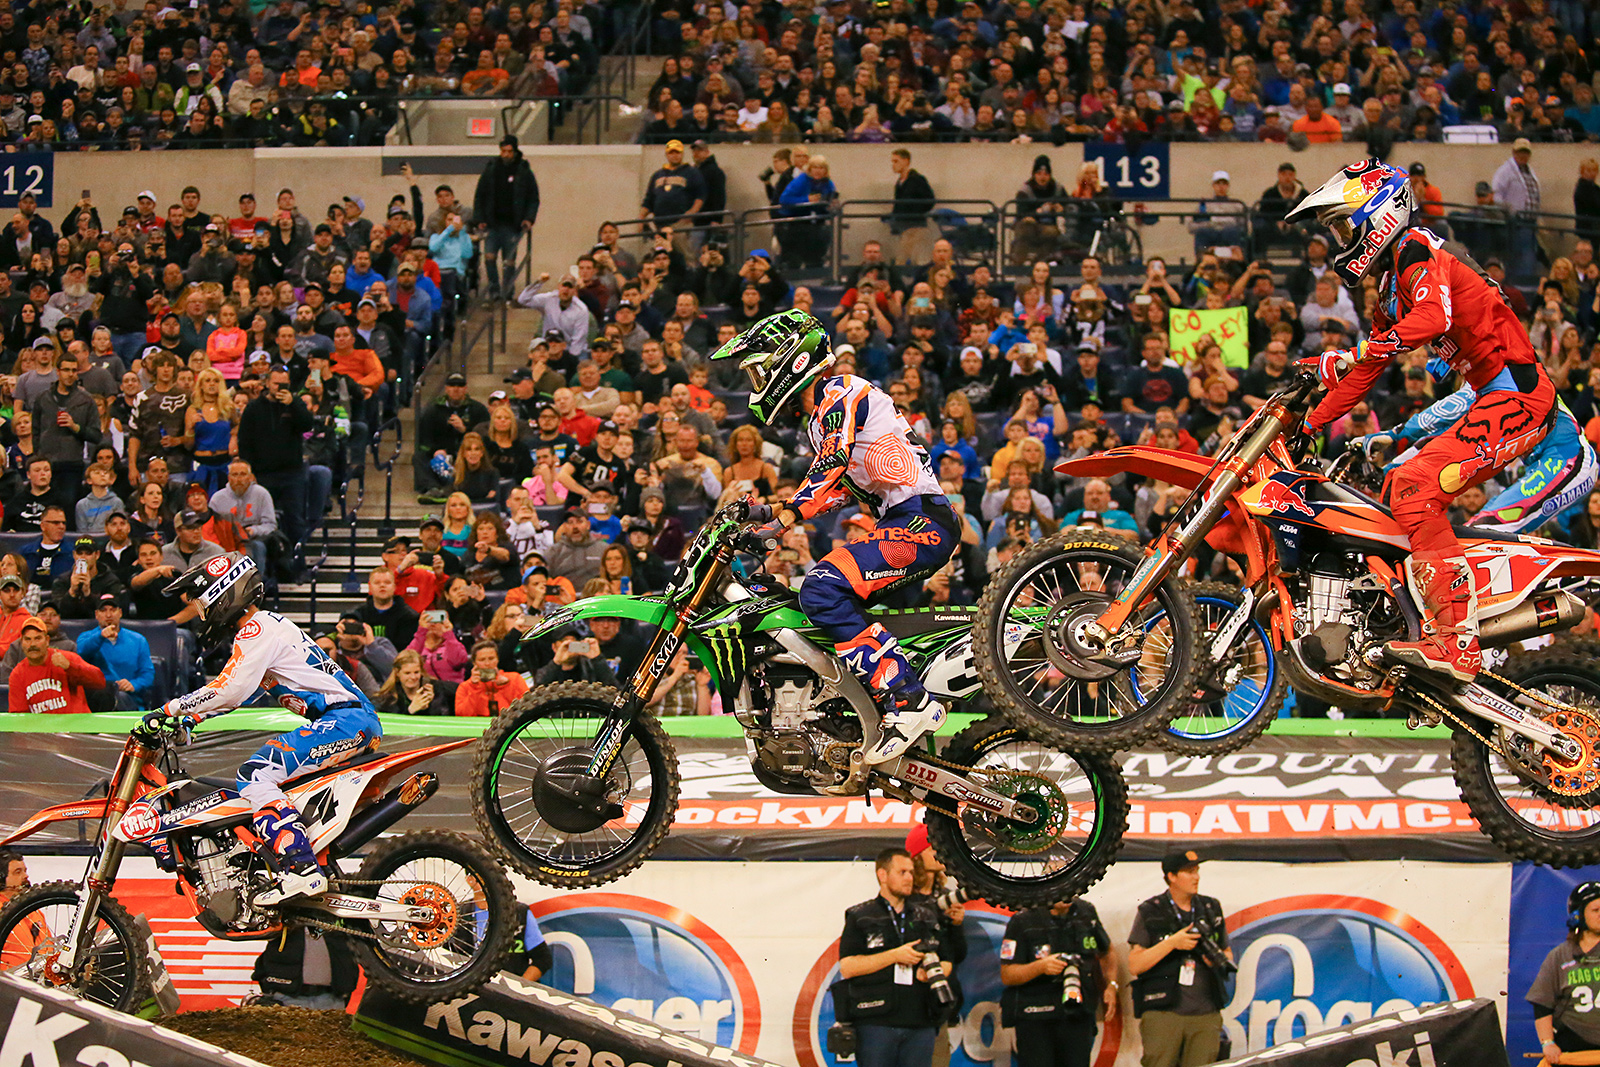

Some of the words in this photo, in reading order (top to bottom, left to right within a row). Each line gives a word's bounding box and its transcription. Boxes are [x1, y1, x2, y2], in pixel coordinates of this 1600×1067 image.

[1094, 155, 1162, 188] 113
[1171, 310, 1202, 334] GO
[794, 354, 808, 371] BELL
[1554, 476, 1594, 507] YAMAHA
[1278, 523, 1298, 535] KTM
[1063, 541, 1120, 552] DUNLOP
[865, 567, 908, 580] Kawasaki
[1128, 556, 1158, 592] MOTOREX
[1476, 556, 1513, 596] 1
[934, 614, 971, 622] Kawasaki
[649, 631, 679, 680] KYB
[28, 696, 68, 714] SKETBALL
[590, 718, 624, 778] DUNLOP
[600, 742, 622, 779] ACERBIS
[171, 804, 189, 814] ROCKY
[189, 792, 220, 808] MOUNTAIN
[301, 786, 340, 826] 4
[539, 865, 590, 878] DUNLOP
[1083, 936, 1098, 949] 66
